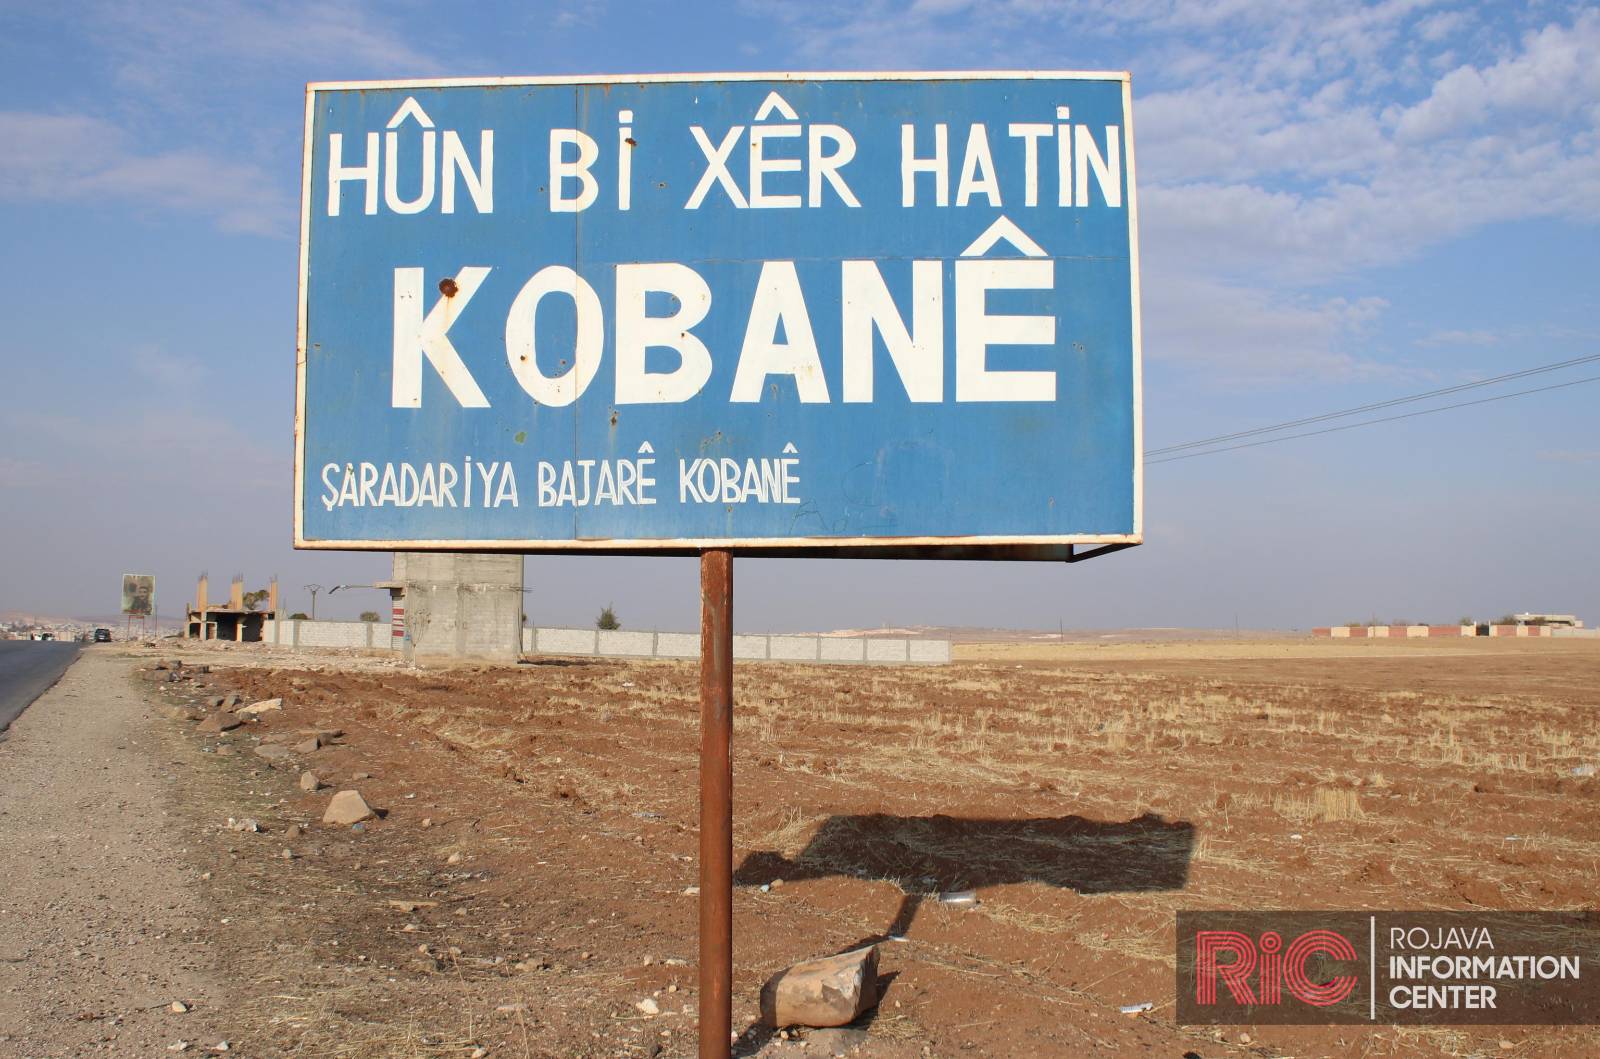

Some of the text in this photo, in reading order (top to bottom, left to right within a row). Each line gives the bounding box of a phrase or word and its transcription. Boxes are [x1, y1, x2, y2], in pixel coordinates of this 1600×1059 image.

[328, 97, 494, 216] HÛN
[684, 91, 862, 209] XÊR
[391, 215, 1057, 410] KOBANÊ
[537, 441, 657, 507] BAJARÊ
[679, 442, 801, 504] KOBANÊ
